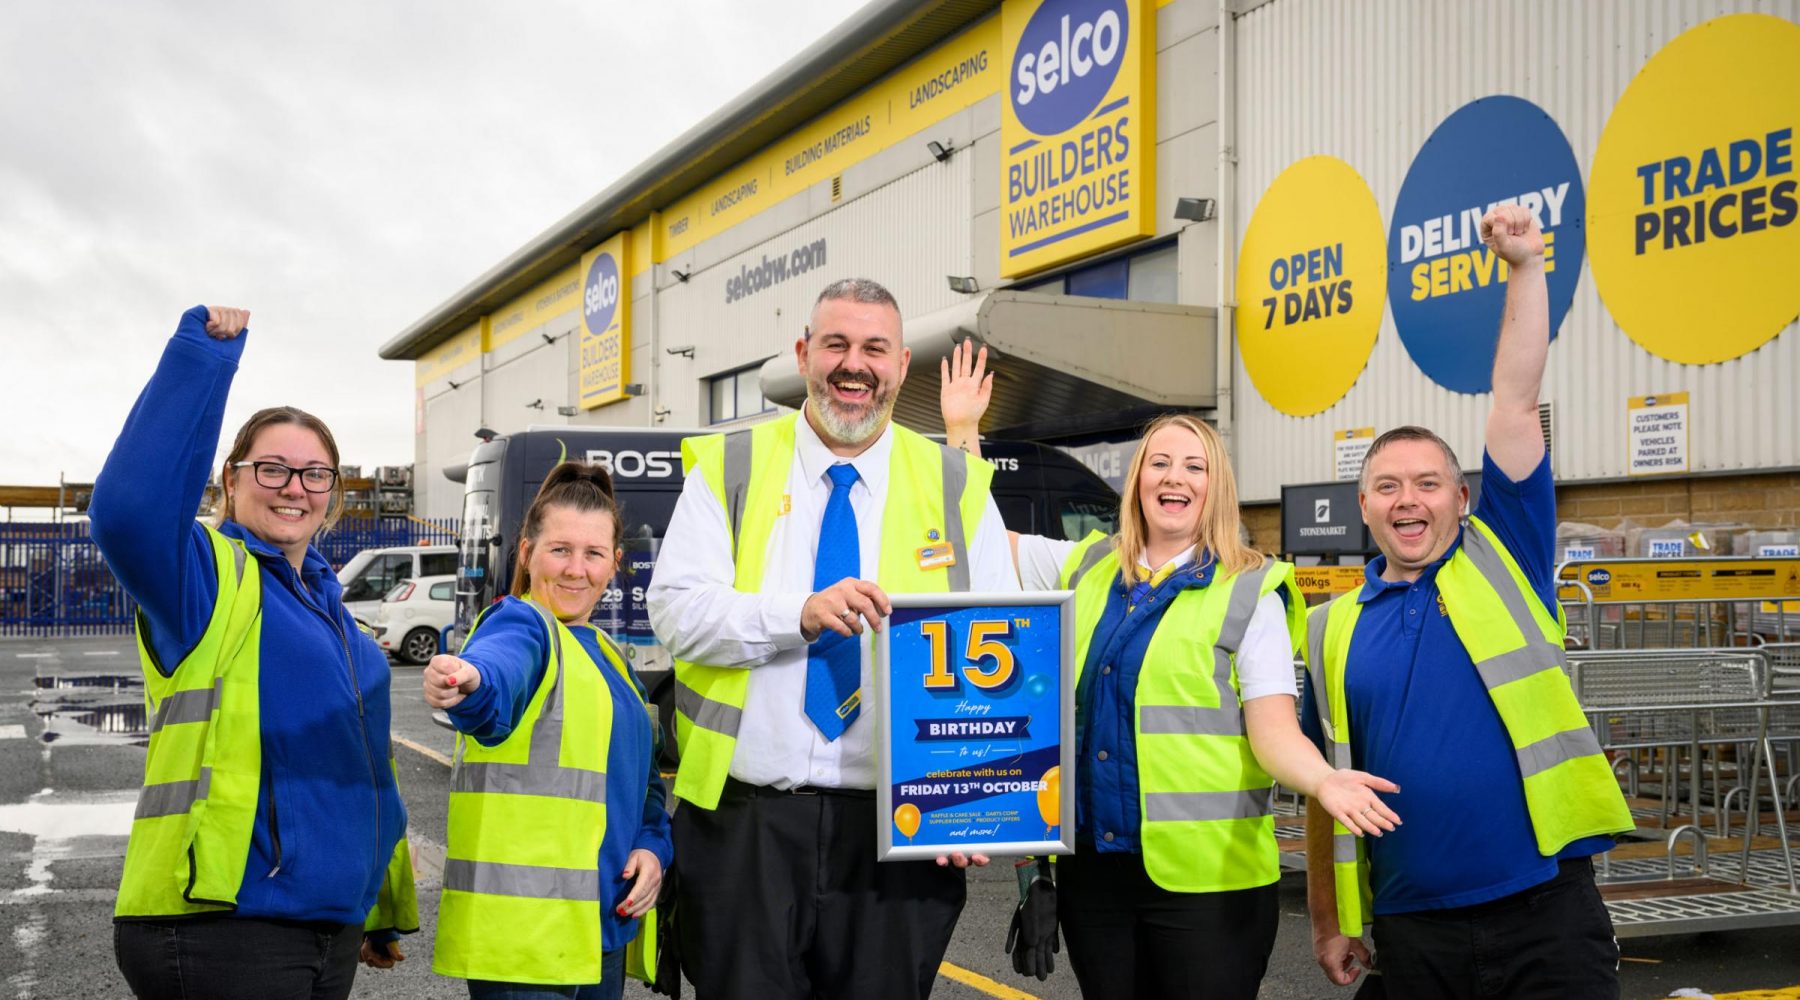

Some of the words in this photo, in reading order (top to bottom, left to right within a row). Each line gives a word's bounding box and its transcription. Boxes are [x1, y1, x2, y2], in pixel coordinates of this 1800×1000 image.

[1017, 9, 1120, 105] selco
[909, 50, 988, 109] LANDSCAPING
[785, 141, 823, 176] BUILDING
[824, 115, 871, 157] MATERIALS
[1009, 116, 1129, 203] BUILDERS
[1637, 127, 1793, 205] TRADE
[710, 178, 757, 216] LANDSCAPING
[1009, 169, 1129, 239] WAREHOUSE
[1400, 182, 1570, 264] DELIVRY
[1635, 180, 1798, 256] PRICES
[725, 238, 827, 304] selcobw.com
[1269, 243, 1342, 290] OPEN
[1411, 231, 1555, 301] SERVIE
[585, 273, 617, 316] selco
[1263, 297, 1277, 330] 7
[1284, 280, 1353, 325] DAYS
[1633, 424, 1660, 433] PLEASE
[1663, 422, 1682, 431] NOTE
[1636, 411, 1679, 423] CUSTOMERS
[1638, 447, 1666, 456] PARKED
[1640, 436, 1675, 446] VEHICLES
[1633, 458, 1663, 467] OWNERS
[1665, 457, 1683, 465] RISK
[1299, 526, 1347, 537] STONEMARKET
[1652, 542, 1682, 552] TRADE
[1588, 570, 1610, 581] selco
[955, 700, 992, 715] Happy
[930, 721, 1016, 736] BIRTHDAY
[960, 745, 968, 757] to
[972, 744, 991, 757] us!
[926, 768, 971, 778] celebrate
[974, 768, 995, 777] with
[996, 768, 1008, 776] us
[1009, 768, 1022, 776] on
[900, 783, 951, 797] FRIDAY
[953, 782, 980, 794] 13TH
[983, 780, 1048, 793] OCTOBER
[949, 826, 969, 837] and
[969, 823, 1000, 837] more!
